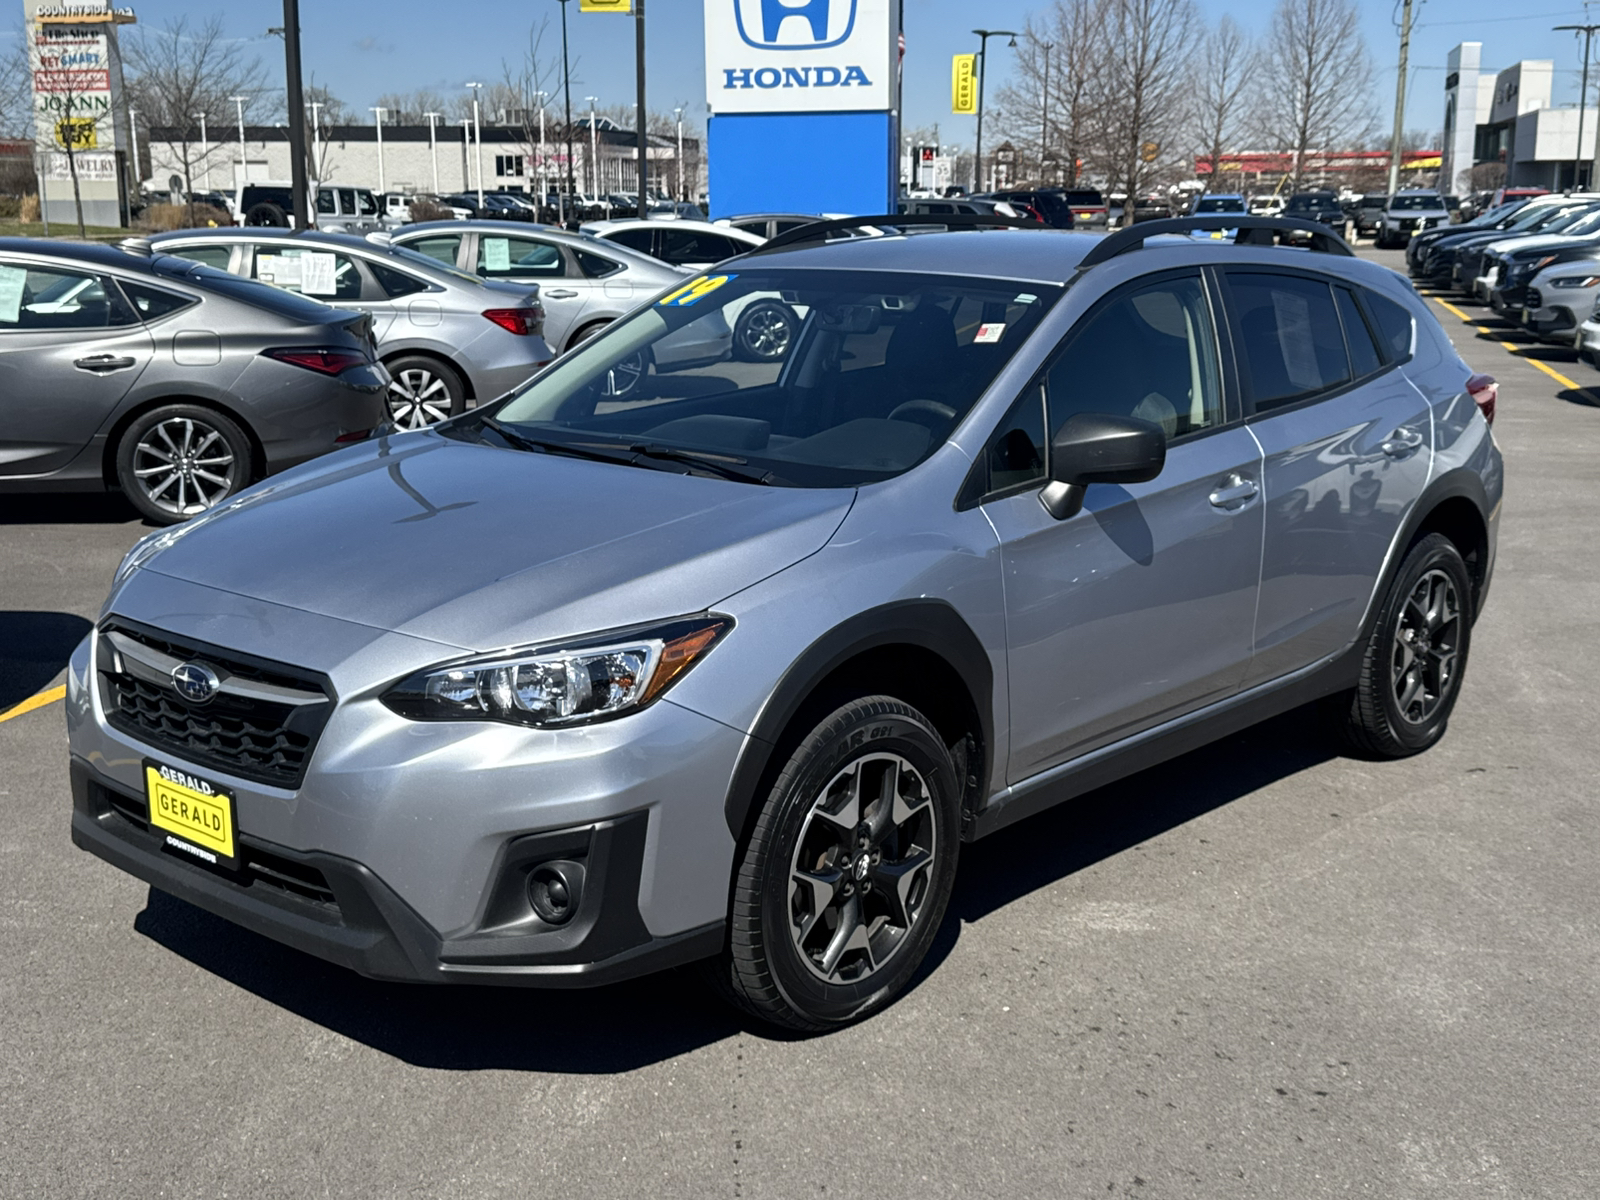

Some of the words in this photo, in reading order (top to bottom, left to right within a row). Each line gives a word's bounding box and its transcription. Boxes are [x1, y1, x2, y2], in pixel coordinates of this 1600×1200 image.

[723, 65, 873, 89] HONDA
[960, 62, 969, 107] GERALD
[659, 275, 728, 305] 19
[160, 793, 220, 831] GERALD
[166, 835, 217, 864] COUNTRYSIDE
